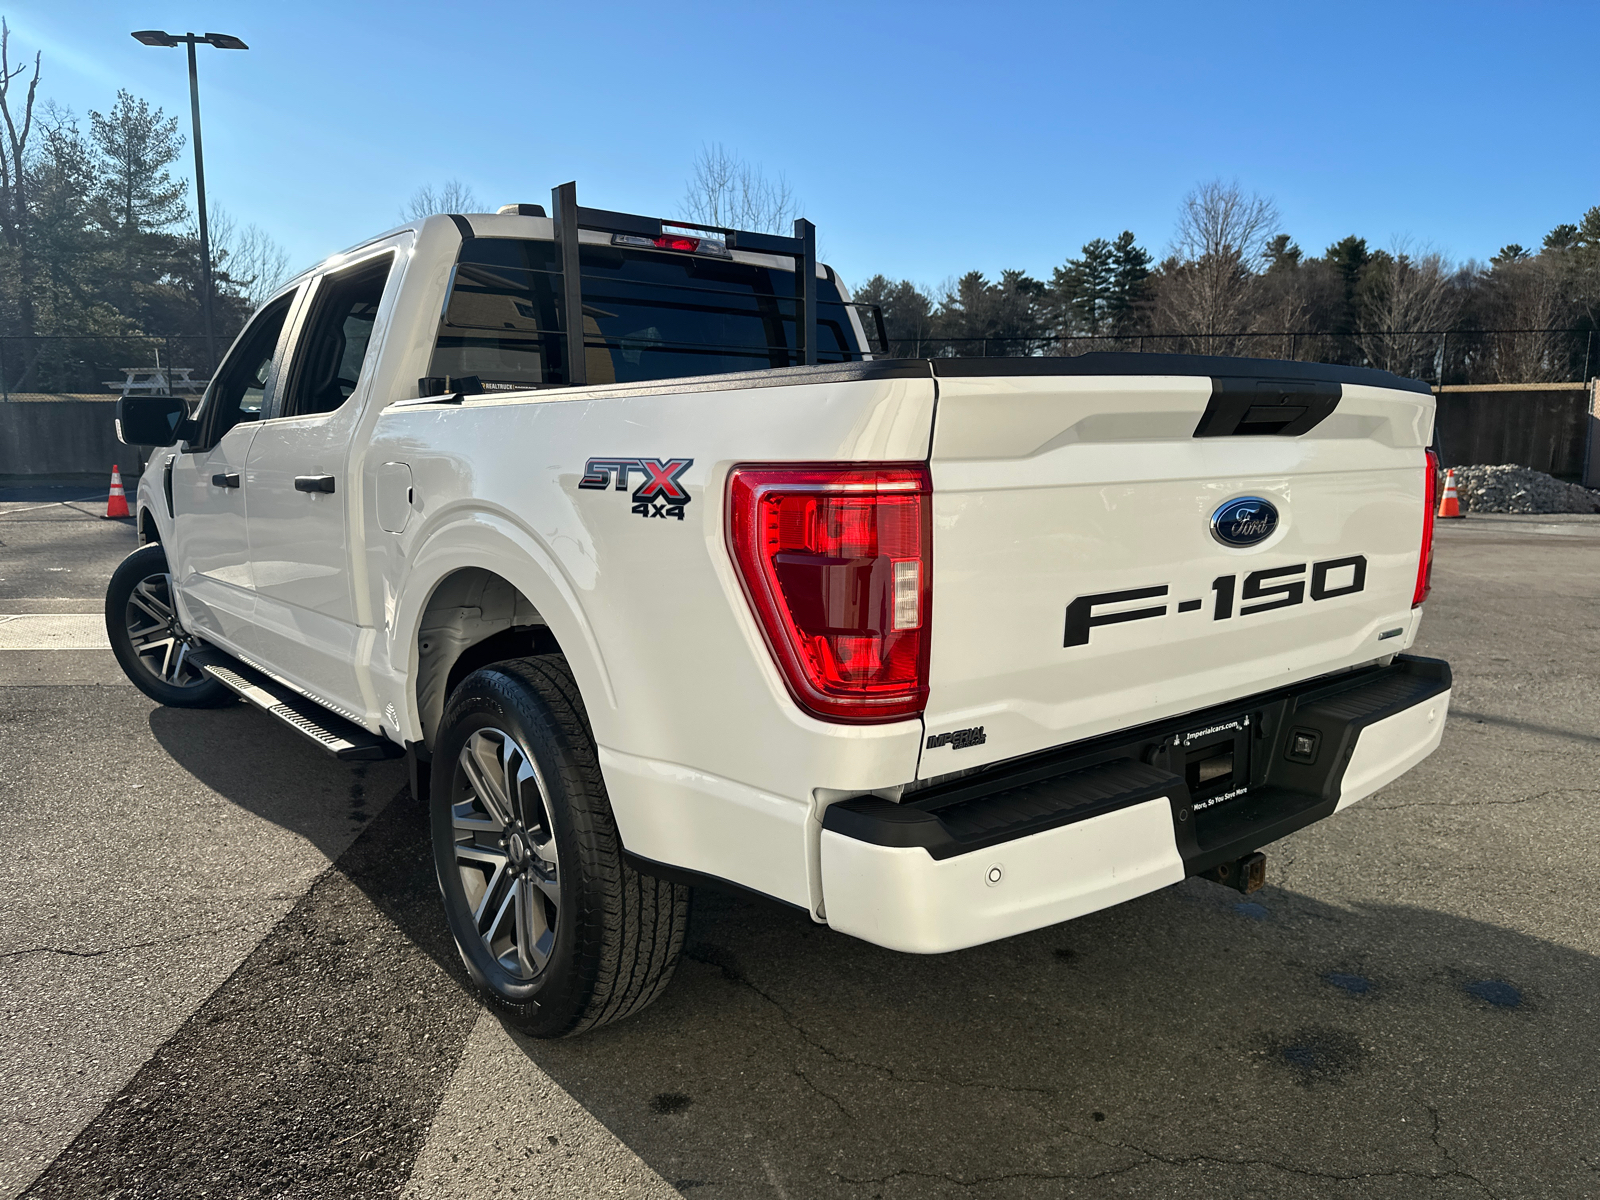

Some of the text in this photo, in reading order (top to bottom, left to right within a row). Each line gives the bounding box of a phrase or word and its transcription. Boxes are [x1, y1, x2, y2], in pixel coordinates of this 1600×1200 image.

[578, 457, 695, 506] STX
[1231, 507, 1270, 537] Ford
[1063, 554, 1368, 648] F-150
[926, 726, 986, 749] IMPERIAL
[1186, 721, 1238, 739] Imperialcars.com
[1224, 791, 1236, 800] Save
[1235, 787, 1247, 796] More
